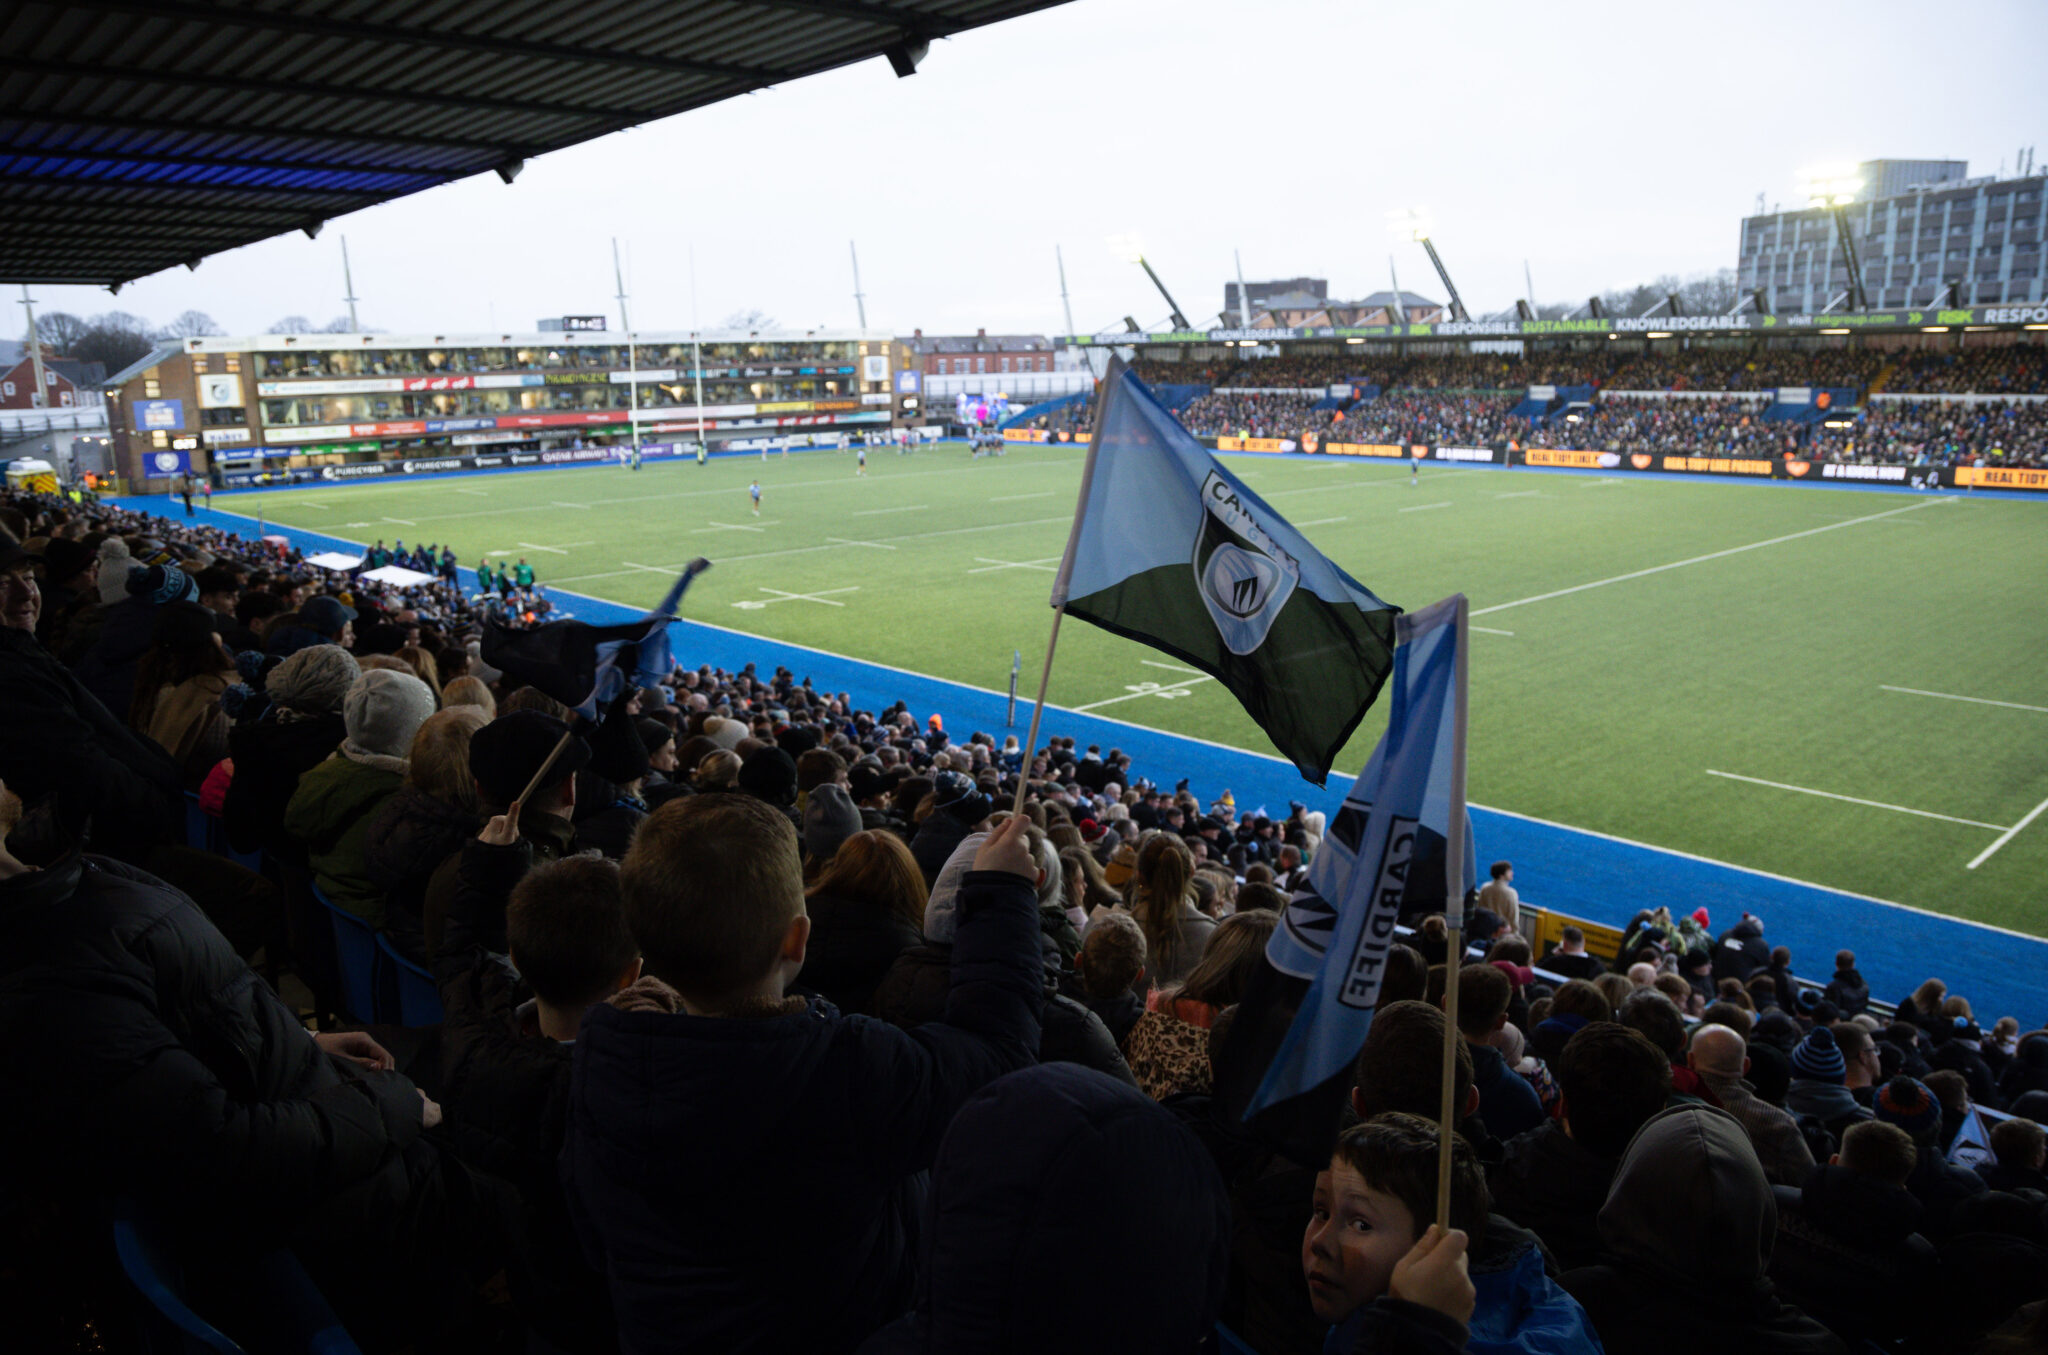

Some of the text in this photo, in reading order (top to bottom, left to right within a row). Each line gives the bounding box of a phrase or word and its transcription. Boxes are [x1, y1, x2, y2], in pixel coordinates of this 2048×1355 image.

[1436, 321, 1519, 335] RESPONSIBLE.
[1521, 319, 1612, 333] SUSTAINABLE.
[1615, 315, 1751, 331] KNOWLEDGEABLE.
[1984, 471, 2048, 484] REAL TIDY
